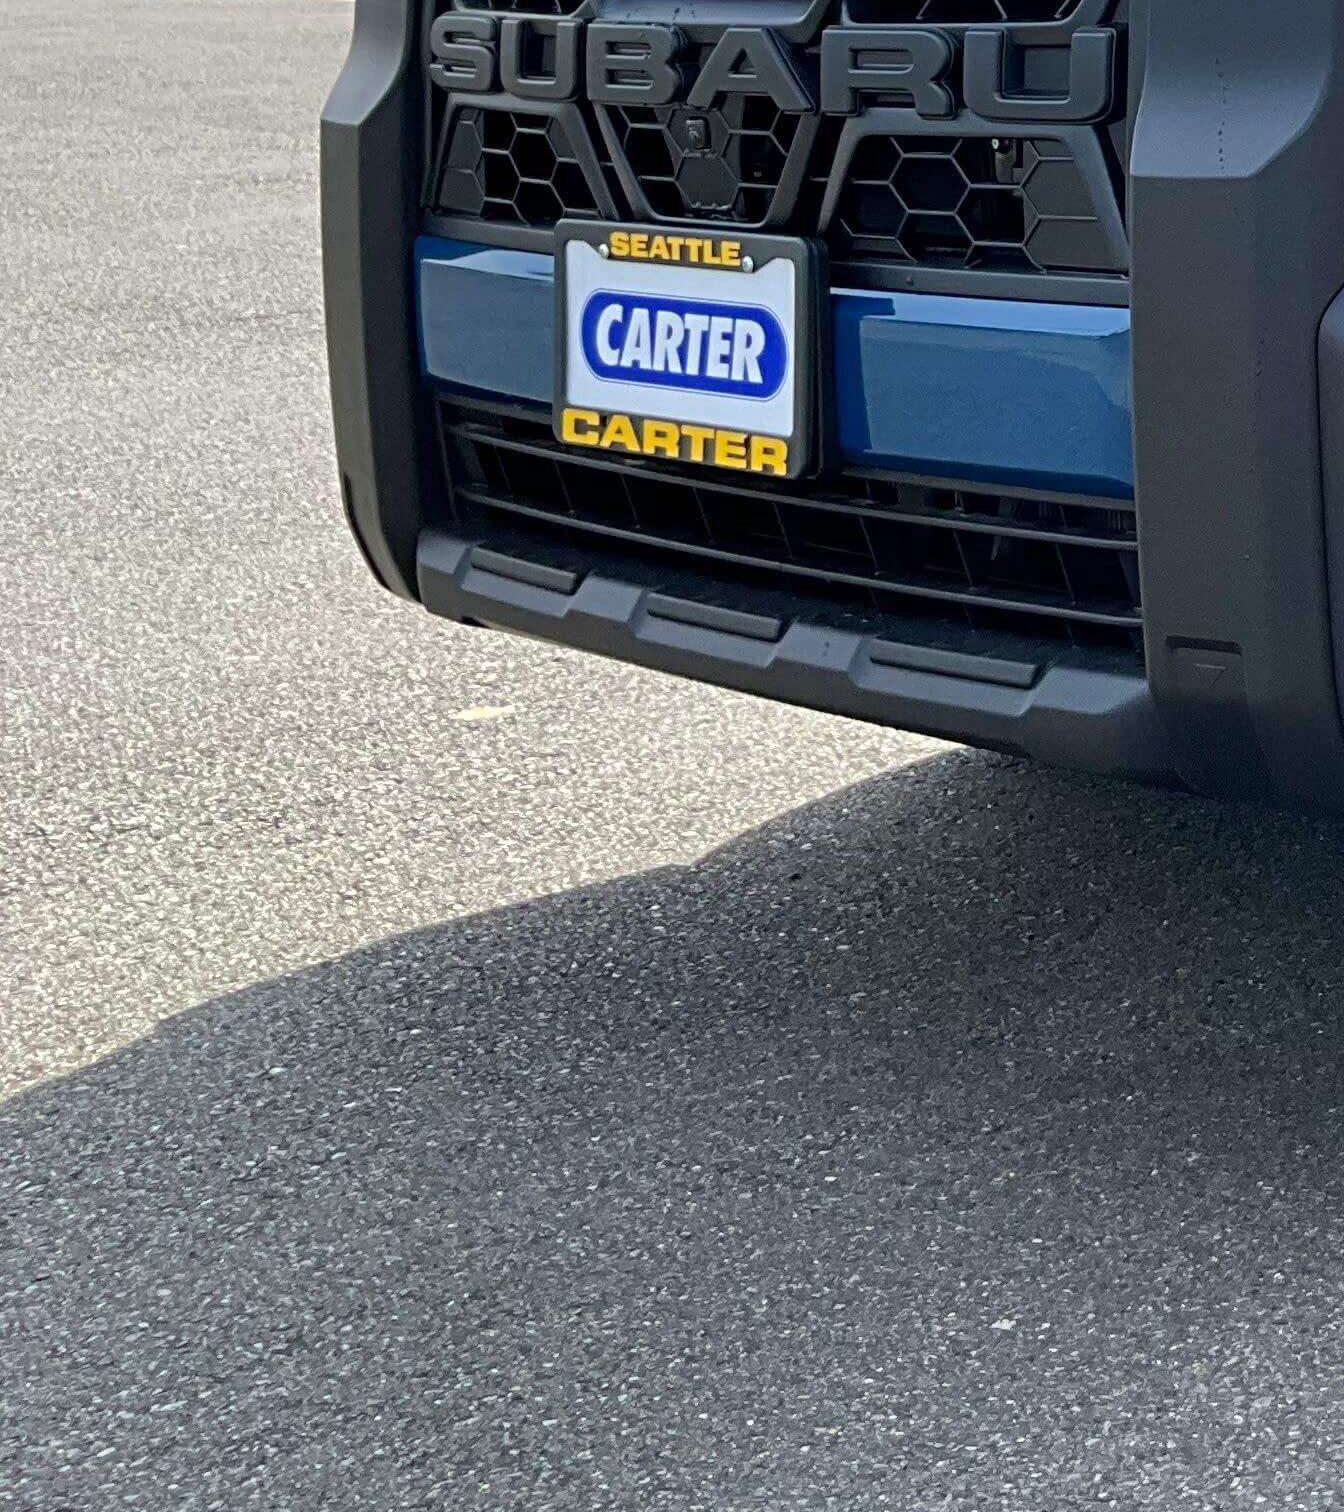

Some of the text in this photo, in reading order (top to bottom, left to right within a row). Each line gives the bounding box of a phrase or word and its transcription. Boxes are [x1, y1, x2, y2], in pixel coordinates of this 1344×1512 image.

[428, 10, 1115, 126] SUBARU
[609, 231, 742, 267] SEATTLE
[595, 303, 766, 384] CARTER
[561, 407, 789, 477] CARTER
